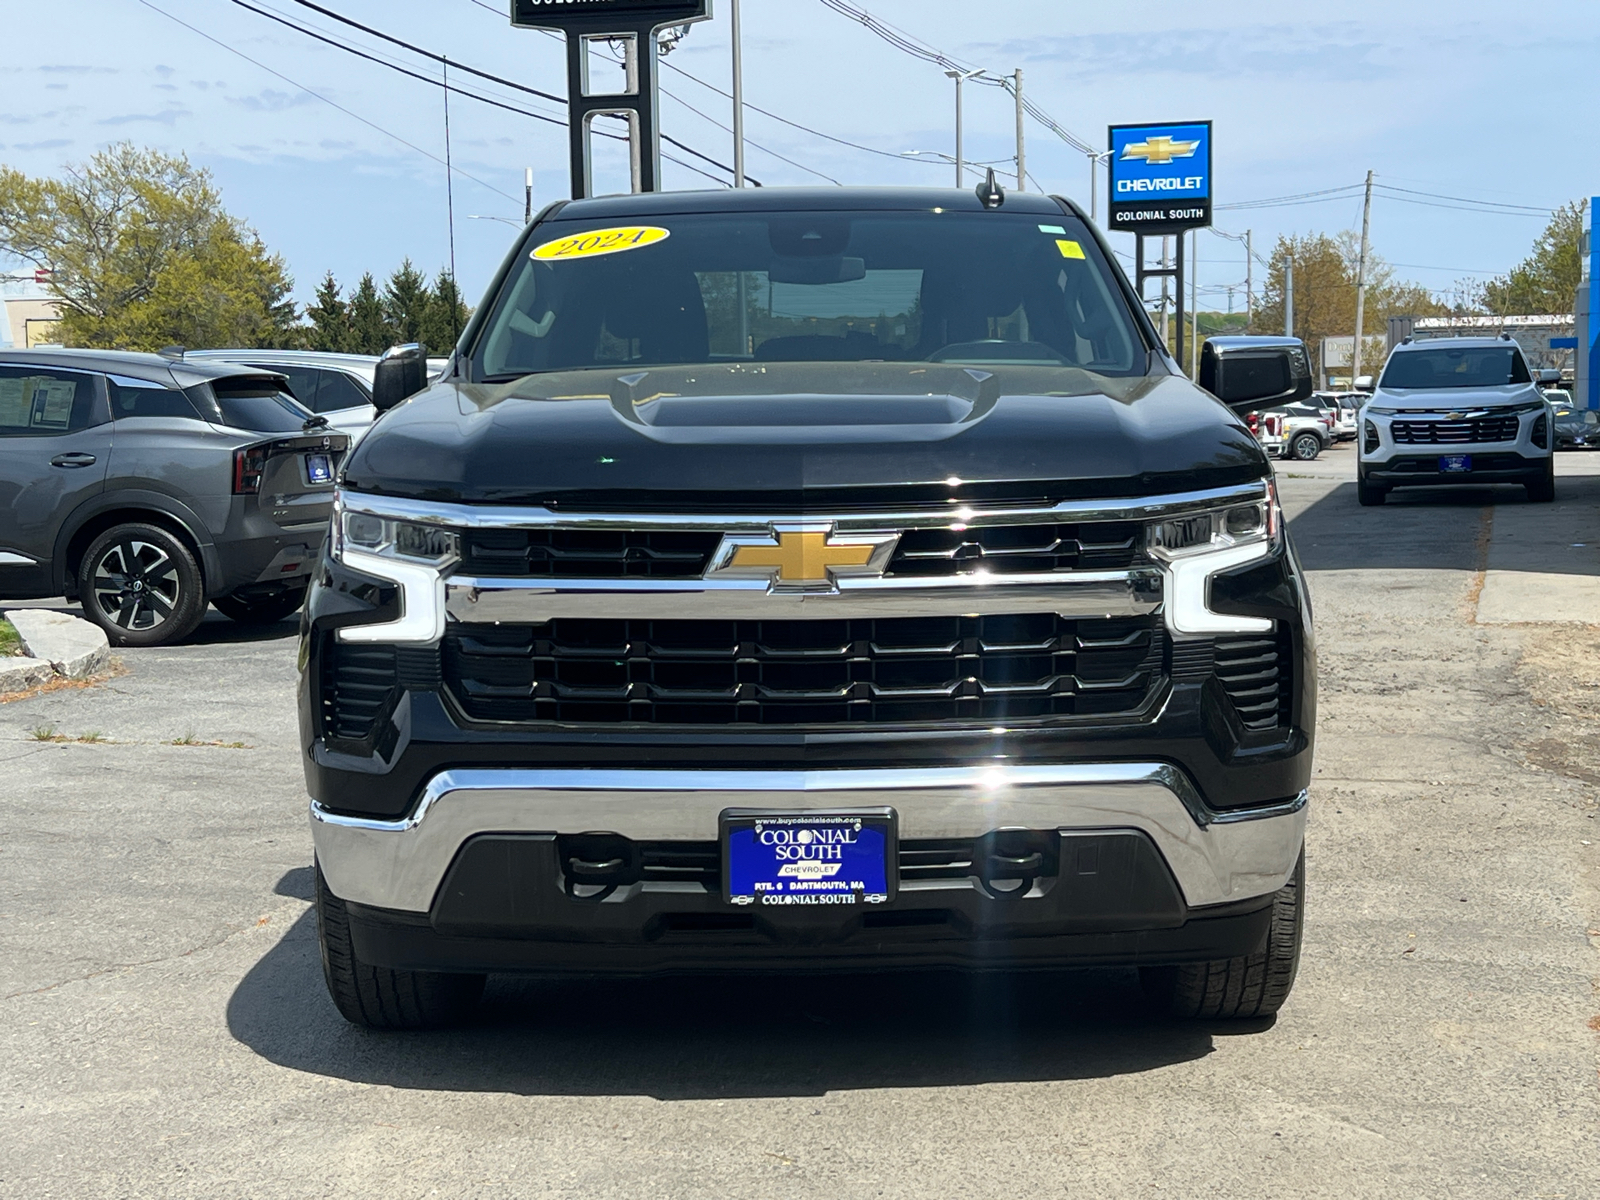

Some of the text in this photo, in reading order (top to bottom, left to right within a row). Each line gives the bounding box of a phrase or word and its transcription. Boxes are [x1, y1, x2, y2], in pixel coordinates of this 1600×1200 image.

[1117, 177, 1203, 192] CHEVROLET
[1116, 209, 1203, 221] COLONIAL SOUTH
[554, 230, 646, 256] 2024
[755, 817, 862, 825] www.buycolonialsouth.com
[760, 829, 857, 845] COLONIAL
[775, 845, 842, 860] SOUTH
[784, 866, 835, 874] CHEVROLET
[754, 881, 865, 891] RTE. 6 DARTMOUTH, MA
[762, 894, 856, 905] COLONIAL SOUTH
